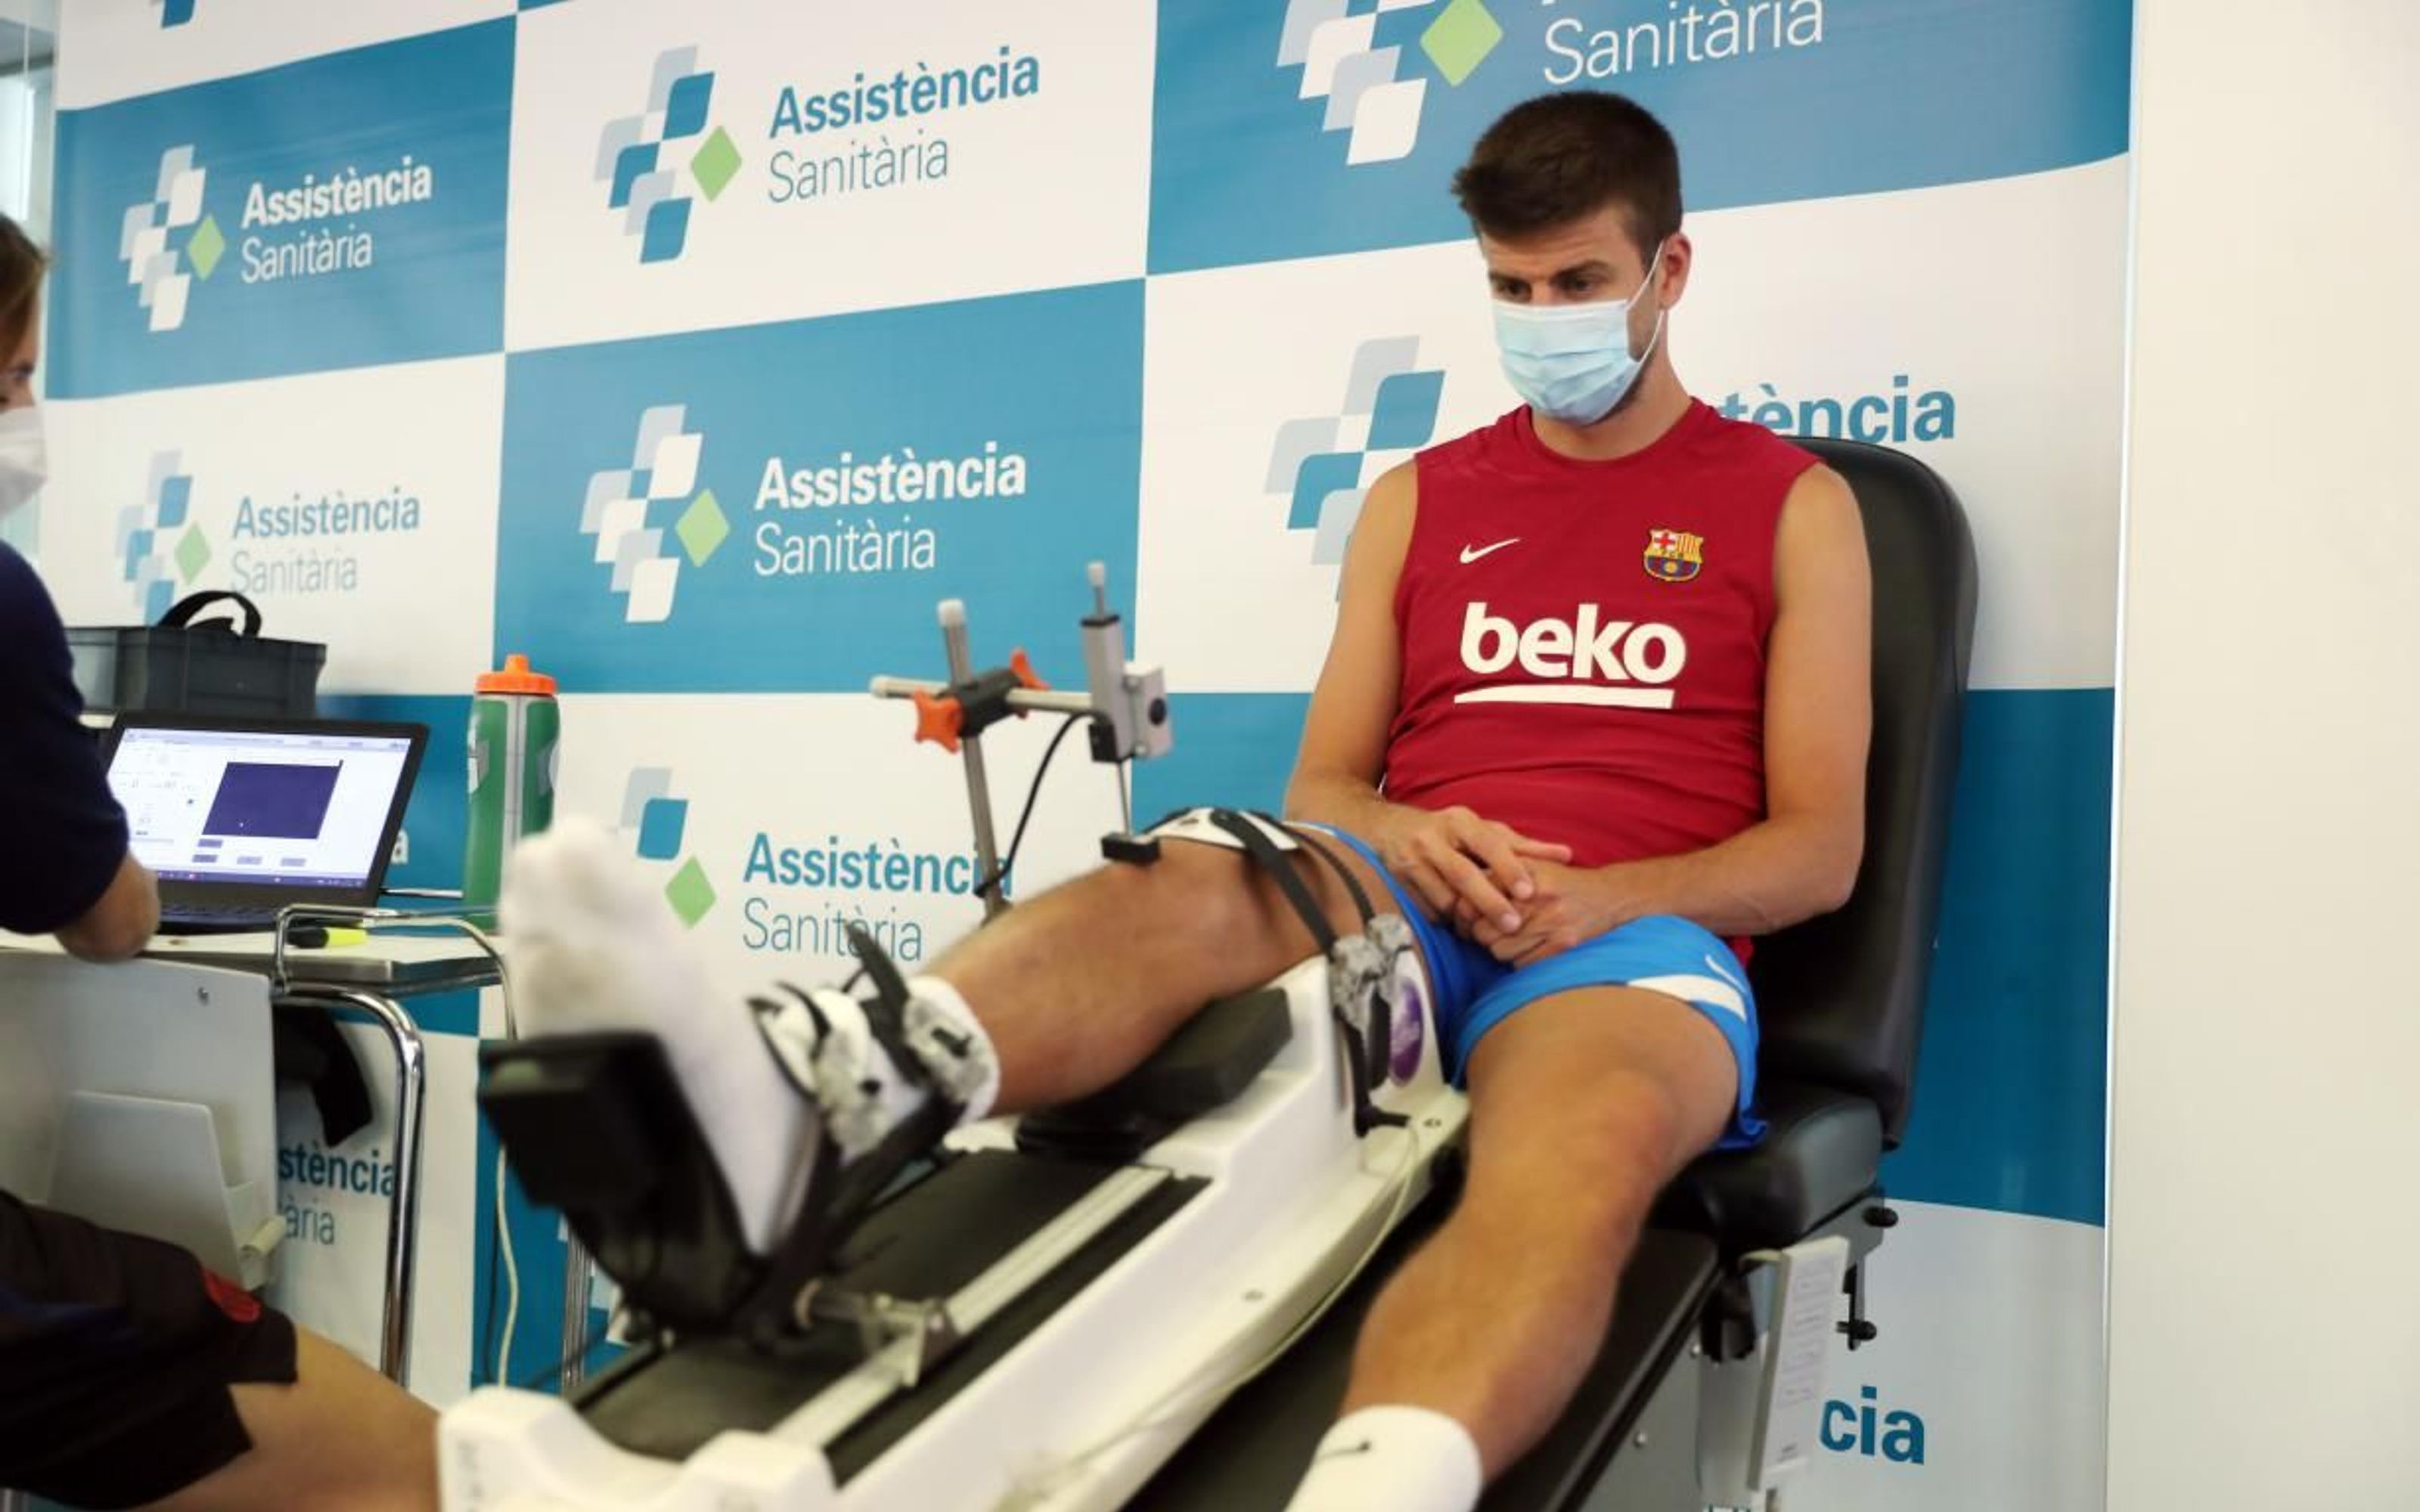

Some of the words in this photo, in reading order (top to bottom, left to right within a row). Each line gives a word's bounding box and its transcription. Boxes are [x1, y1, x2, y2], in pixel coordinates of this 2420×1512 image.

[1544, 0, 1823, 85] Sanitària
[769, 45, 1040, 139] Assistència
[241, 156, 432, 228] Assistència
[768, 132, 949, 203] Sanitària
[241, 225, 374, 284] Sanitària
[1719, 375, 1956, 444] tència
[755, 441, 1026, 510] Assistència
[232, 485, 420, 538] Assistència
[755, 516, 936, 575] Sanitària
[231, 546, 358, 593] Sanitària
[1460, 602, 1687, 683] beko
[278, 1139, 395, 1197] stència
